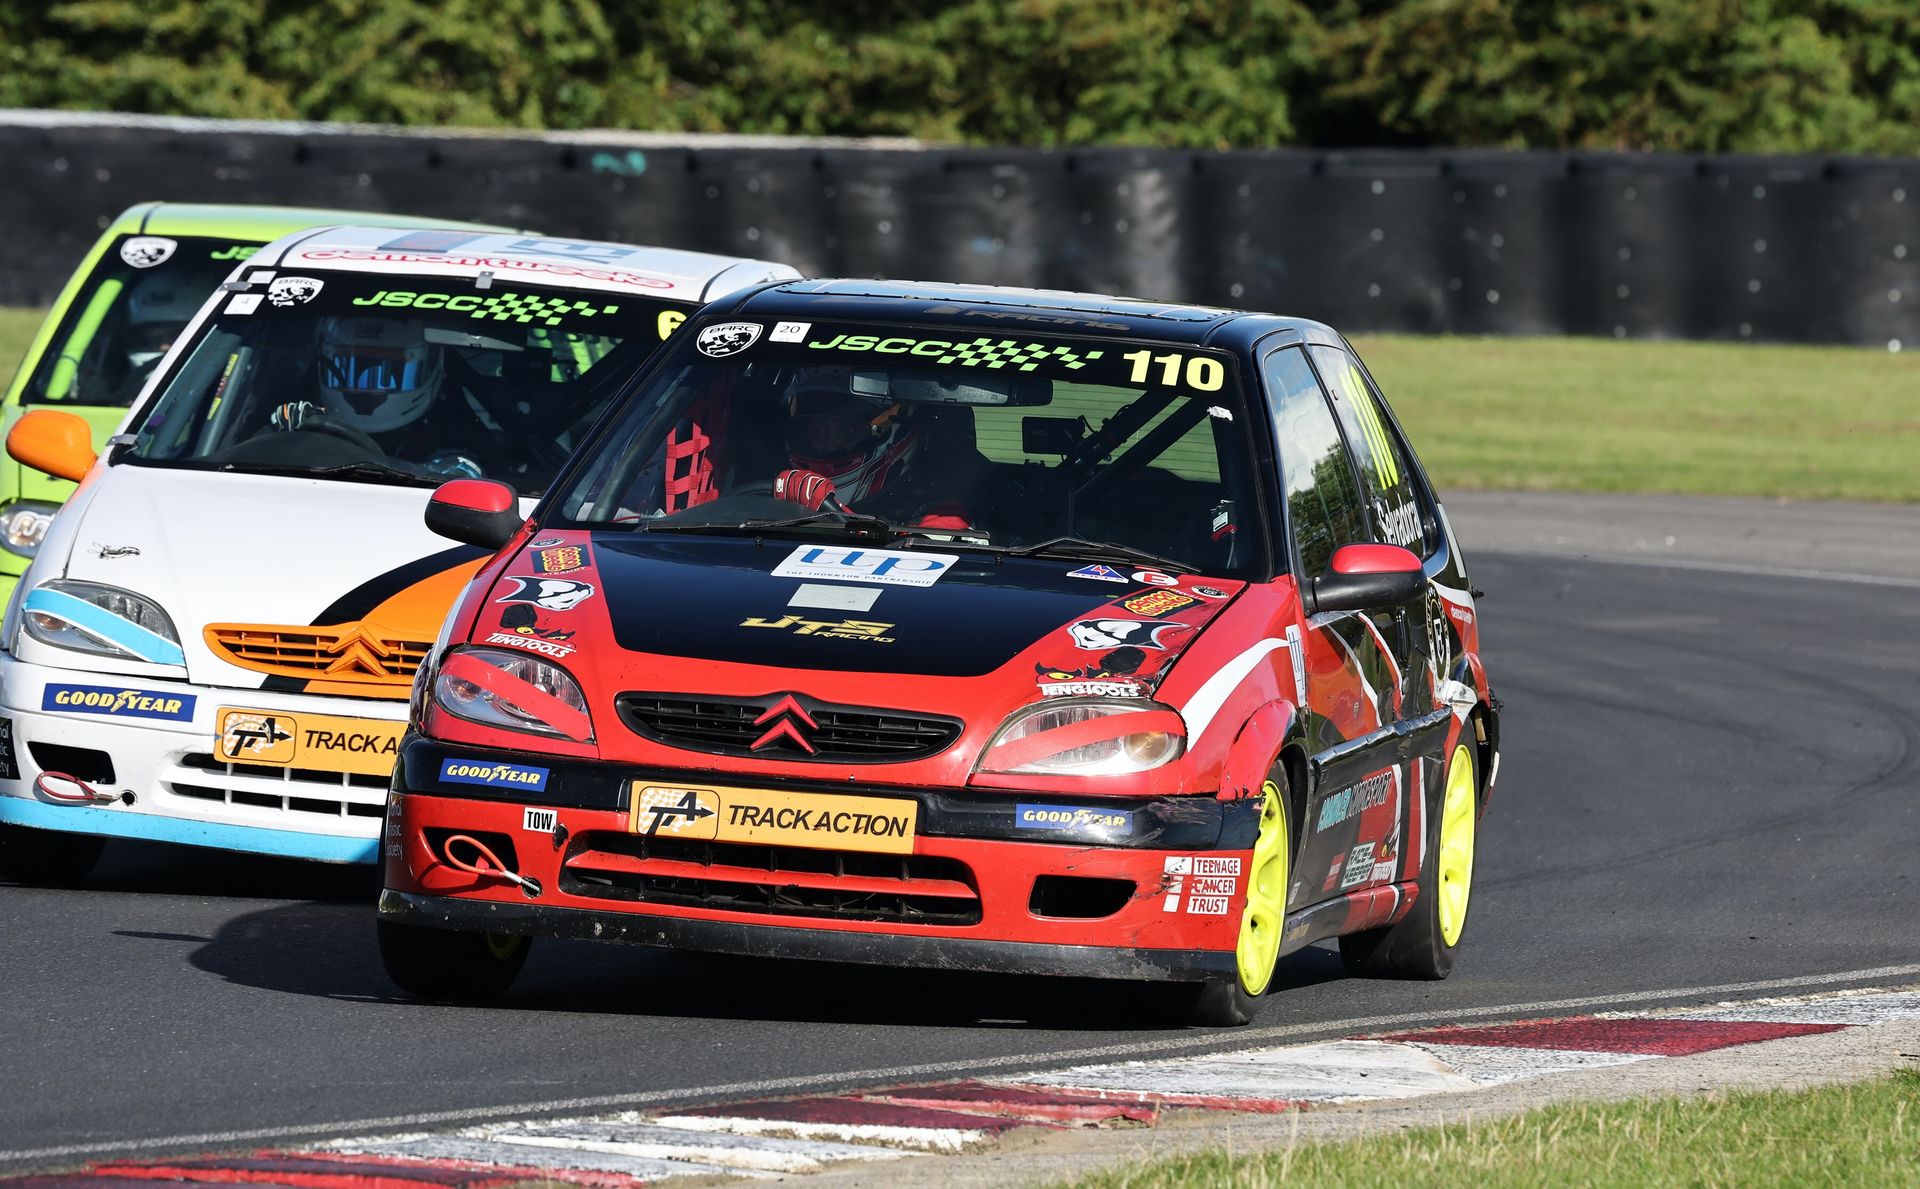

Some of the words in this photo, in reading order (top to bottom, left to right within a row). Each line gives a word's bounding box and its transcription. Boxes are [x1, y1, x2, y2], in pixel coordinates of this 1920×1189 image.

[352, 291, 487, 312] JSCC
[709, 325, 756, 334] BARC
[779, 325, 801, 334] 20
[808, 334, 954, 357] JSCC
[1123, 350, 1224, 392] 110
[813, 631, 896, 643] RACING
[305, 730, 380, 754] TRACK
[526, 811, 553, 830] TOW
[728, 804, 813, 831] TRACK
[813, 812, 909, 838] ACTION
[1196, 859, 1239, 874] TEENAGE
[1194, 879, 1234, 894] CANCER
[1191, 898, 1226, 913] TRUST
